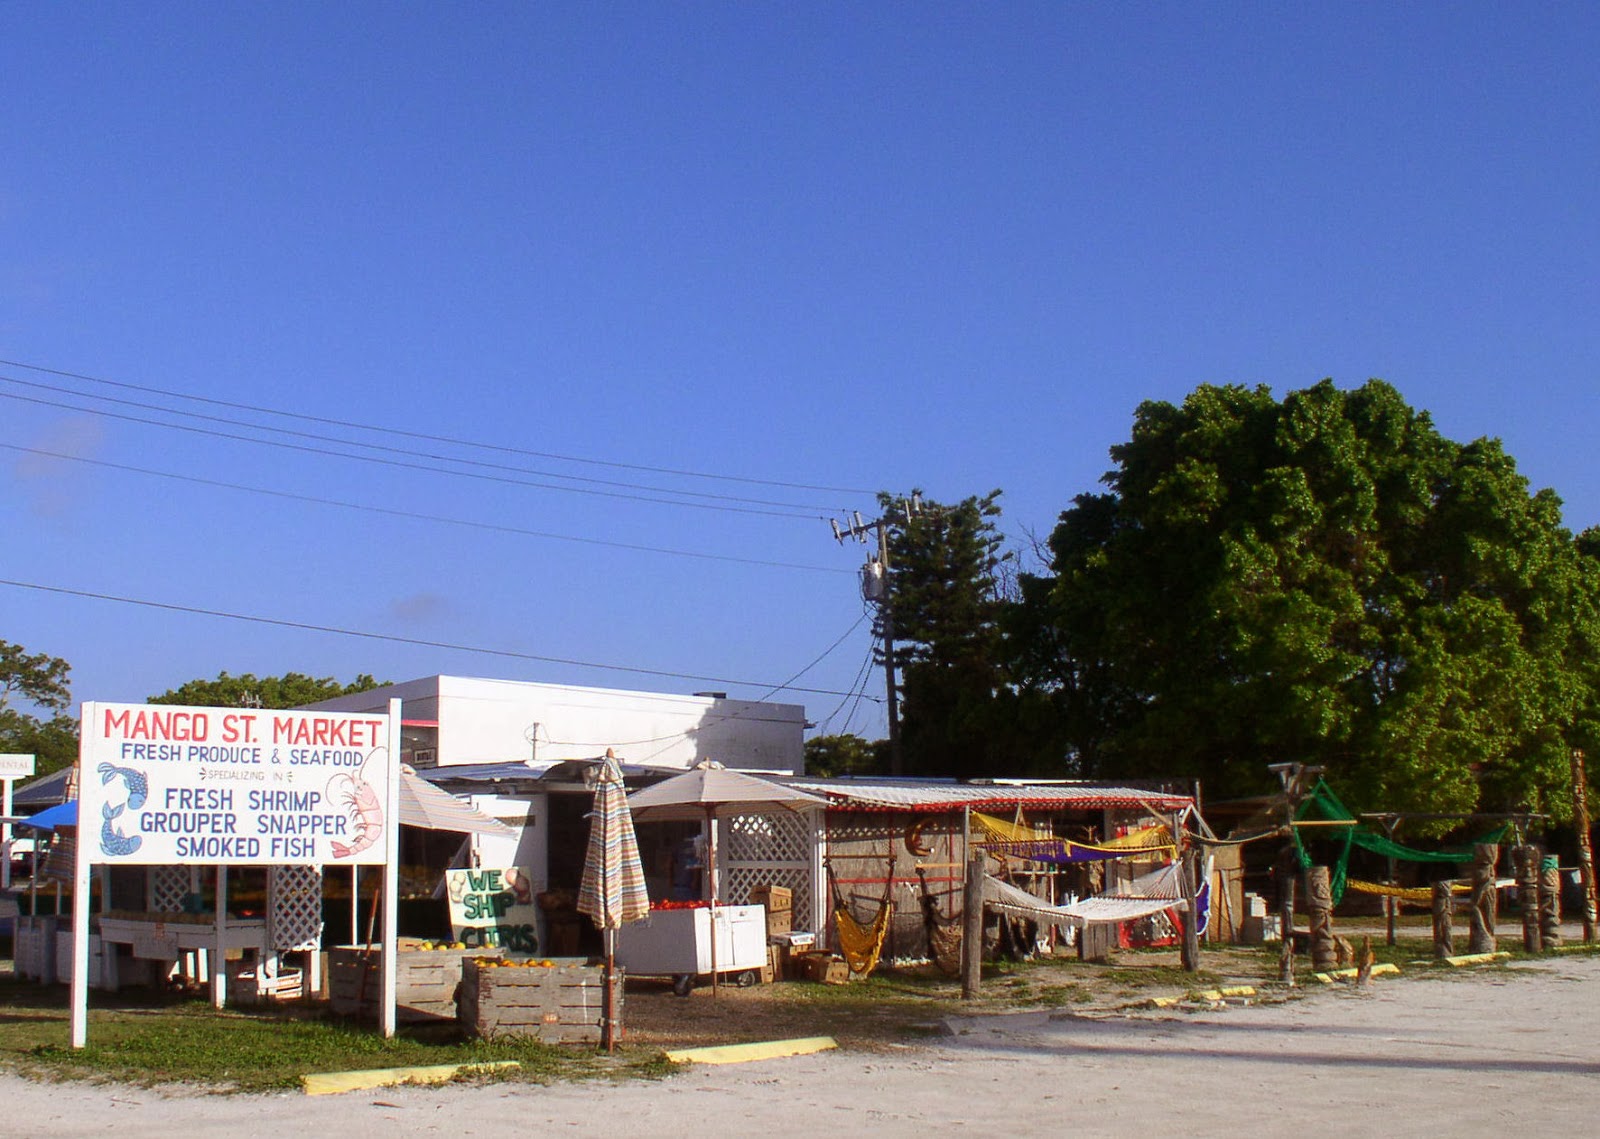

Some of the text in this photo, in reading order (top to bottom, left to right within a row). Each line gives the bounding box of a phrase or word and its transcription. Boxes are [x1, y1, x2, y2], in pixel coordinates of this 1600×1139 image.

[104, 708, 383, 748] MANGO ST. MARKET
[121, 742, 364, 767] FRESH PRODUCE & SEAFOOD
[207, 770, 284, 782] SPECIALIZING IN
[165, 787, 321, 812] FRESH SHRIMP
[140, 811, 347, 835] GROUPER SNAPPER
[176, 836, 315, 858] SMOKED FISH
[466, 869, 504, 892] WE
[463, 892, 516, 920] SHIP
